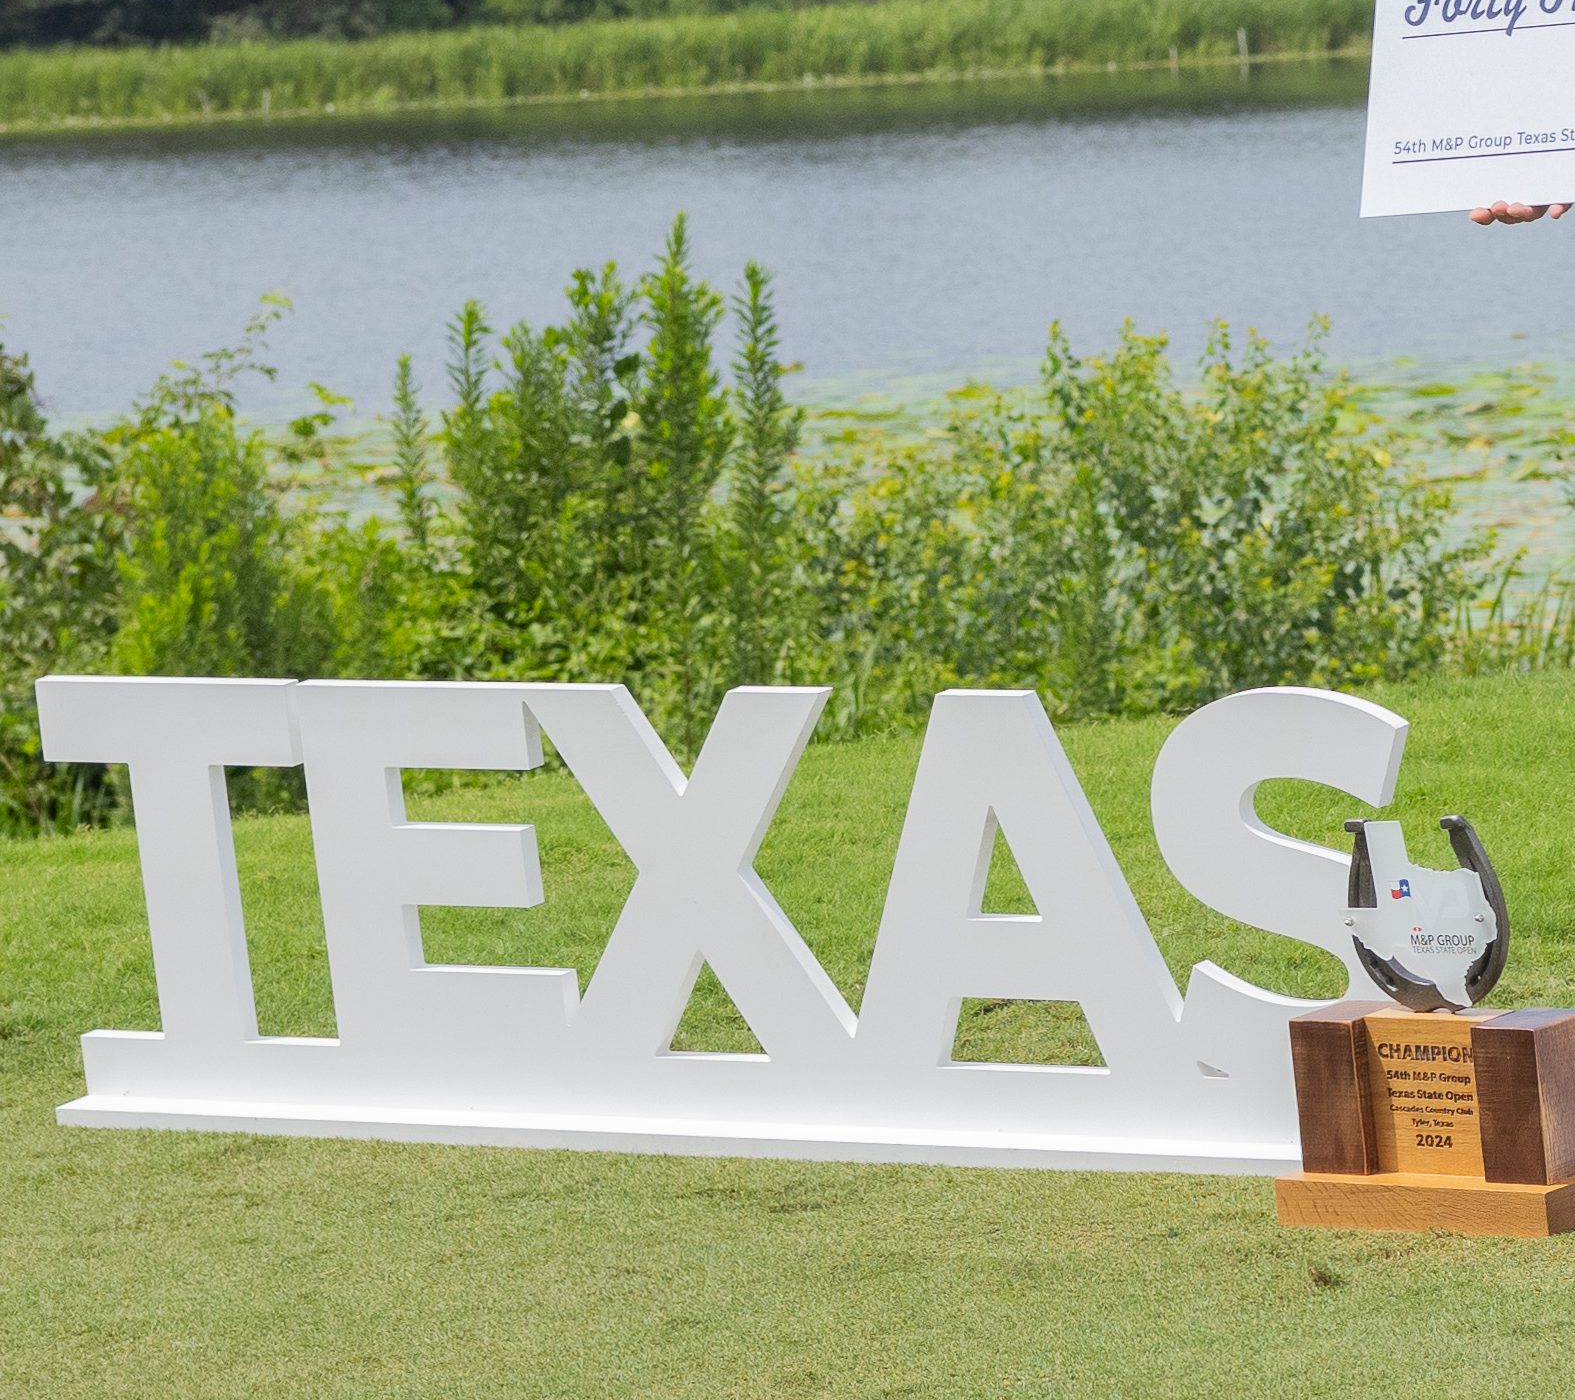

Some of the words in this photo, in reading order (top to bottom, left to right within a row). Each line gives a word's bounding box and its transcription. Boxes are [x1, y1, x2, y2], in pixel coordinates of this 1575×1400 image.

[1394, 140, 1427, 155] 54th
[1431, 138, 1464, 151] M&P
[1468, 134, 1513, 151] Group
[1516, 129, 1557, 146] Texas
[37, 674, 1410, 1140] TEXAS
[1410, 934, 1434, 946] M&P
[1437, 934, 1475, 947] GROUP
[1412, 946, 1434, 954] TEXAS
[1435, 946, 1456, 954] STATE
[1377, 1043, 1474, 1064] CHAMPION
[1386, 1070, 1411, 1081] 54th
[1412, 1071, 1437, 1082] M&P
[1439, 1073, 1472, 1087] Group
[1386, 1087, 1416, 1099] Texas
[1416, 1090, 1444, 1100] State
[1445, 1091, 1474, 1103] Open
[1389, 1104, 1424, 1113] Cascades
[1425, 1106, 1455, 1116] Country
[1456, 1108, 1474, 1116] Club
[1411, 1119, 1432, 1127] Tyler,
[1433, 1119, 1454, 1128] Texas
[1416, 1134, 1454, 1149] 2024
